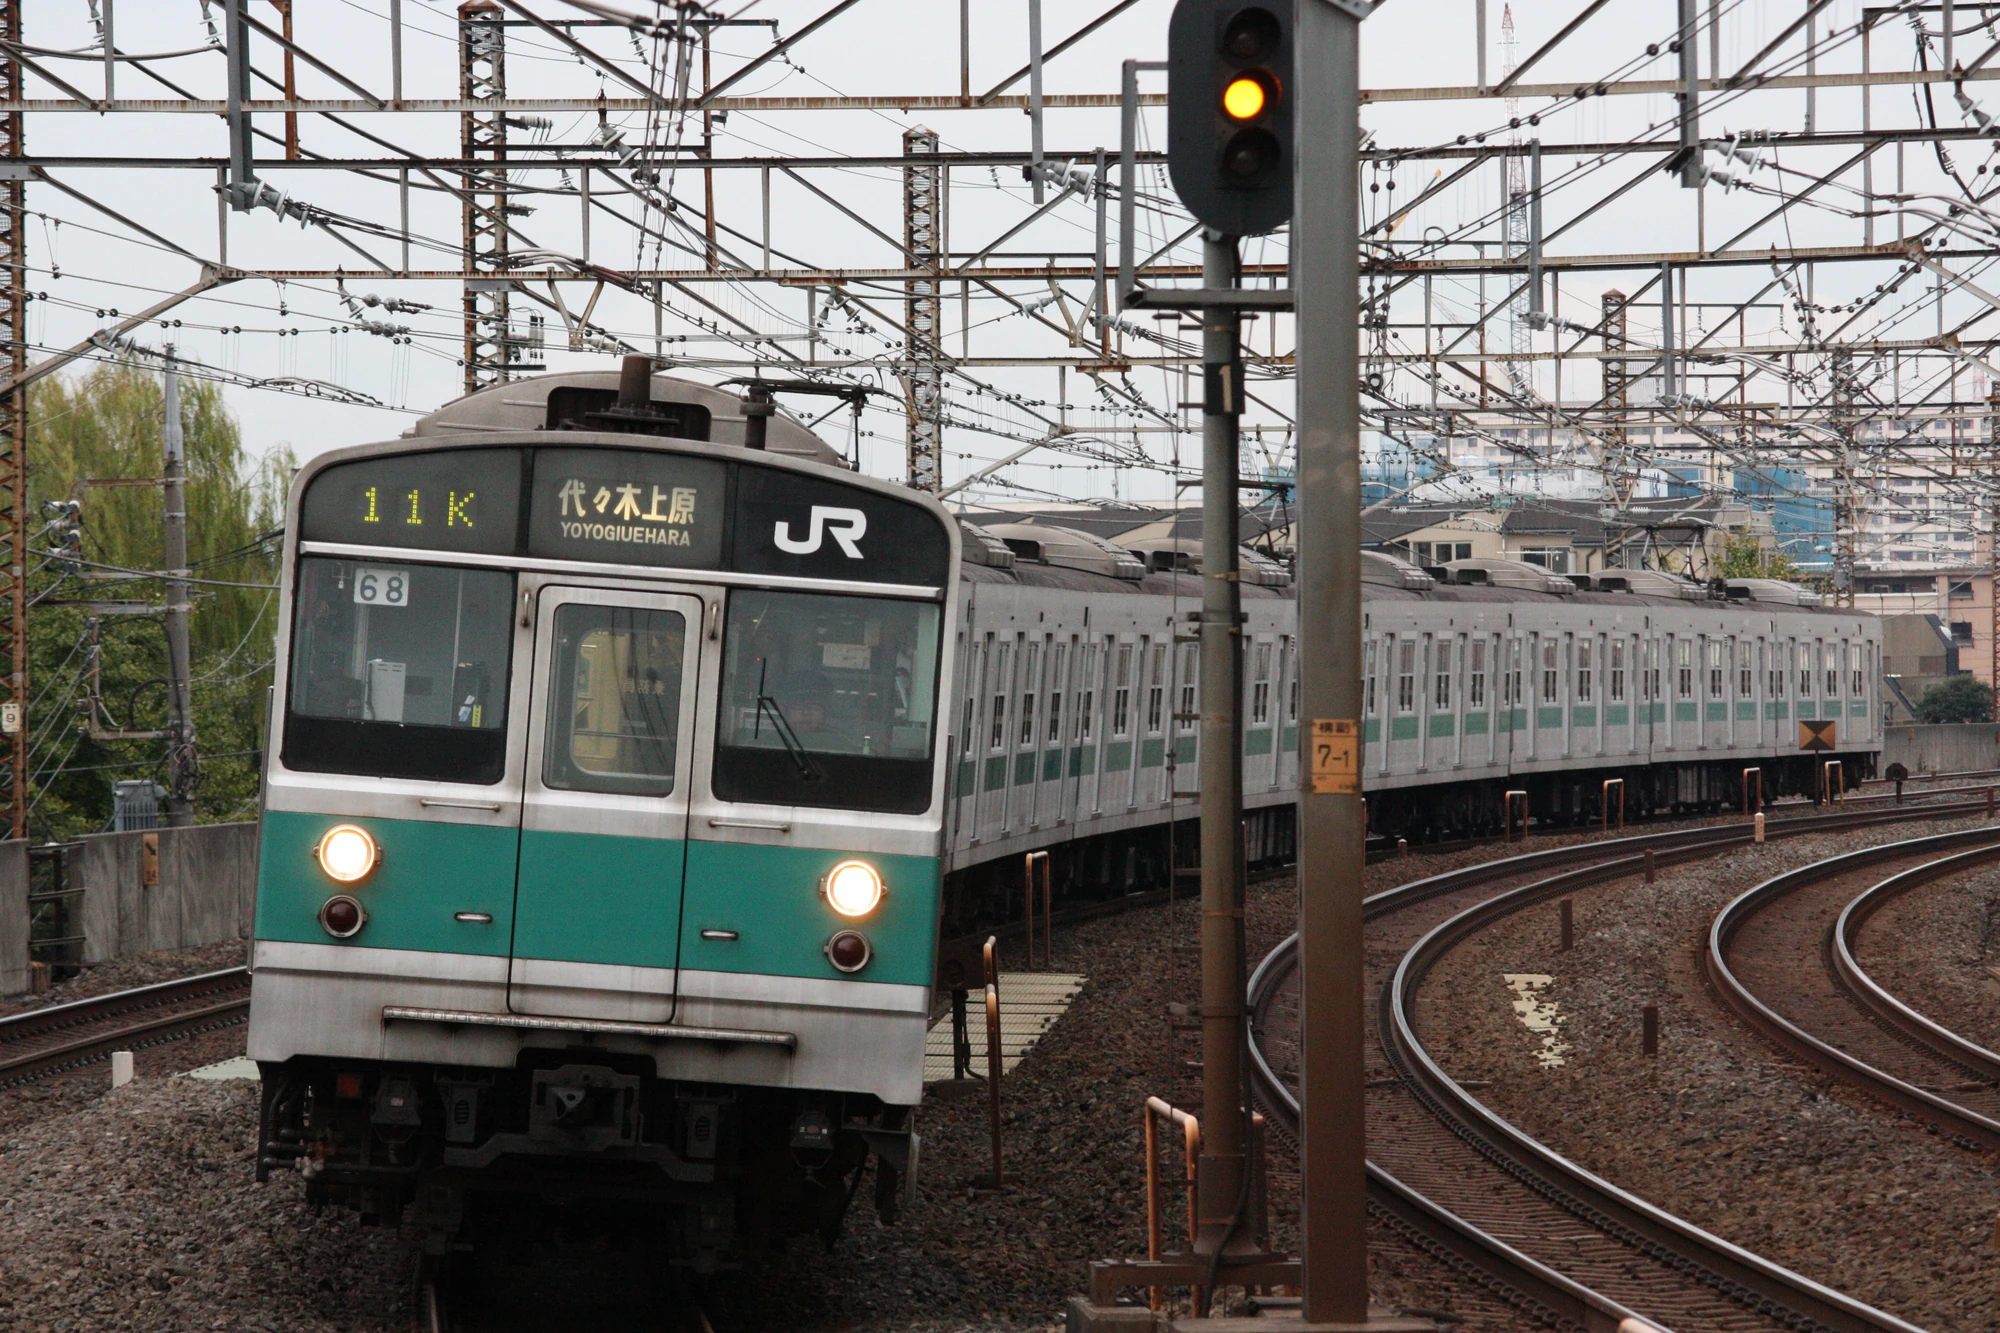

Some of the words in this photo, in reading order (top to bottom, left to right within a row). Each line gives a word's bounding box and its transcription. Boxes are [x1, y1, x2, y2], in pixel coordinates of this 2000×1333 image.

[1219, 365, 1232, 412] 1
[364, 487, 474, 526] 11K
[558, 479, 697, 525] 代々木上原
[560, 521, 690, 546] YOYOGIUEHARA
[774, 505, 867, 559] JR
[360, 574, 403, 603] 68
[1318, 744, 1349, 768] 7-1
